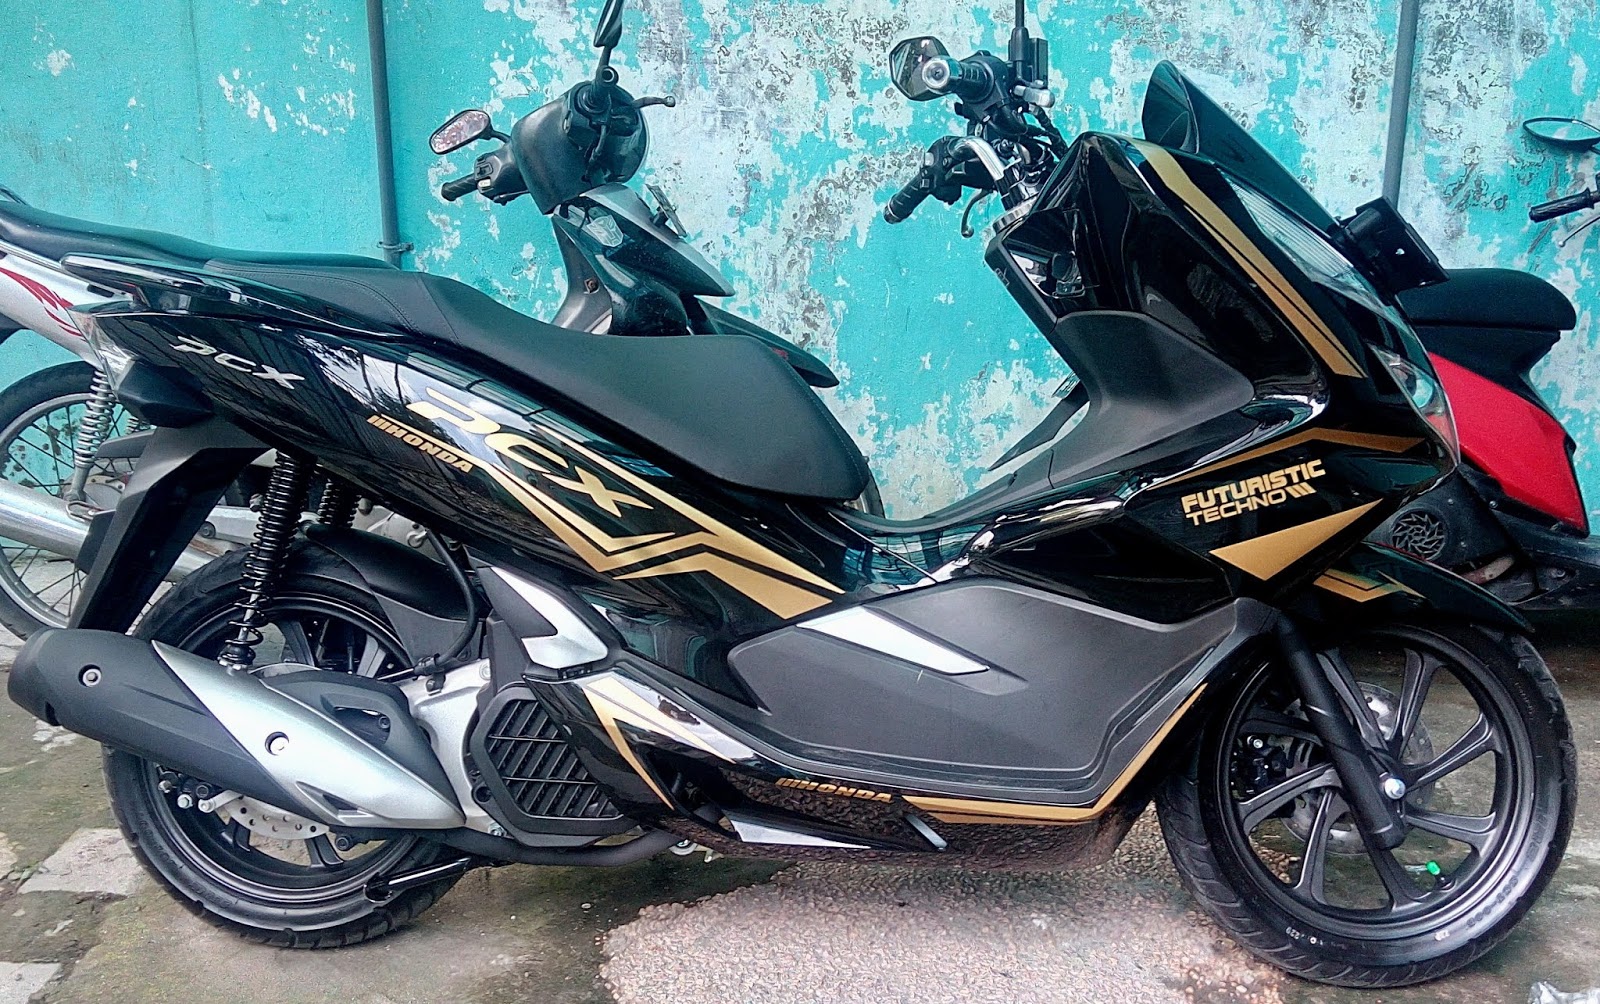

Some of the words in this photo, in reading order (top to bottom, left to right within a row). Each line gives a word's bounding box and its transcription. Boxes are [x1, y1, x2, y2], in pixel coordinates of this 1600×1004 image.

[169, 336, 305, 389] PCX
[384, 424, 473, 473] HONDA
[406, 387, 654, 517] PCX
[1181, 459, 1326, 514] FUTURISTIC
[1186, 489, 1287, 526] TECHNO
[796, 780, 892, 804] HONDA
